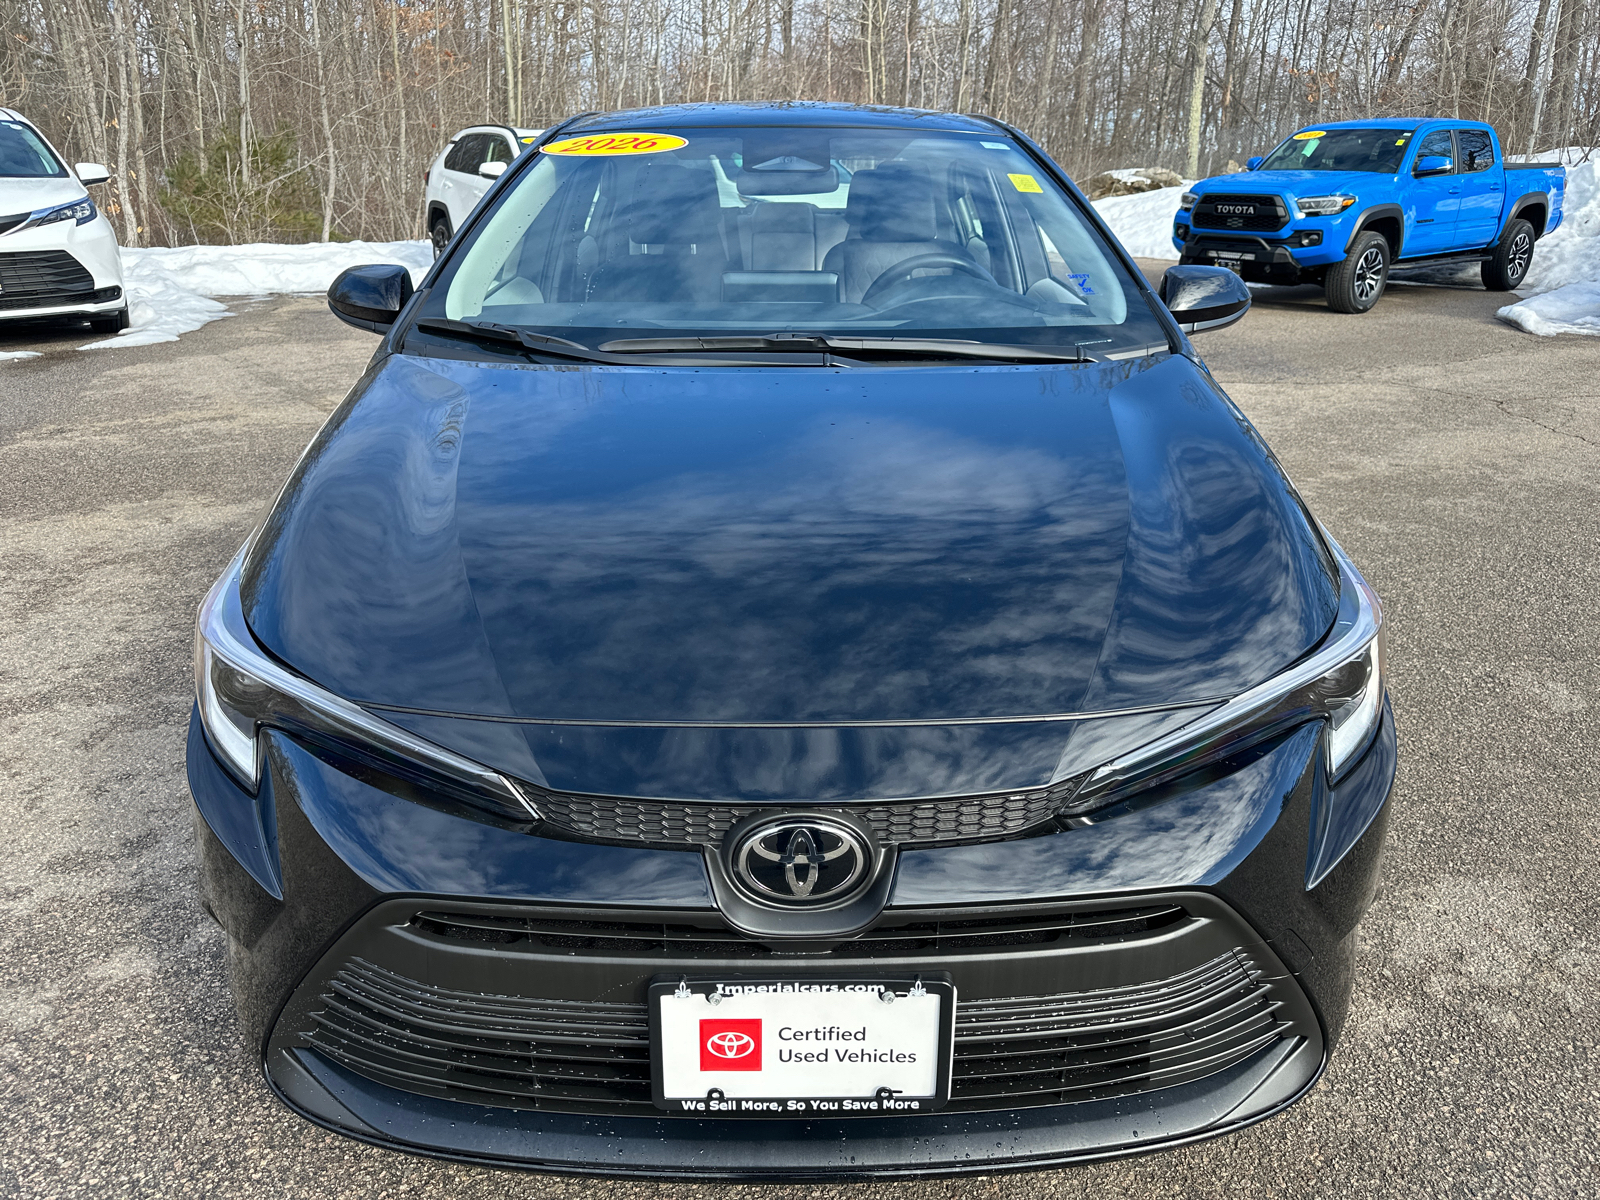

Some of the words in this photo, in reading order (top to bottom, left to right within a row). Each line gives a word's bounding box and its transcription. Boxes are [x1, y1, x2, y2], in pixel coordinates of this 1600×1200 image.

[560, 137, 667, 152] 2026
[1217, 205, 1254, 214] TOYOTA
[716, 982, 886, 995] Imperialcars.com
[778, 1027, 866, 1041] Certified
[778, 1049, 828, 1063] Used
[834, 1049, 917, 1063] Vehicles
[682, 1100, 705, 1110] We
[709, 1100, 737, 1110] Sell
[741, 1100, 783, 1112] More,
[787, 1100, 806, 1110] So
[810, 1100, 838, 1110] You
[842, 1100, 878, 1110] Save
[883, 1099, 920, 1110] More
